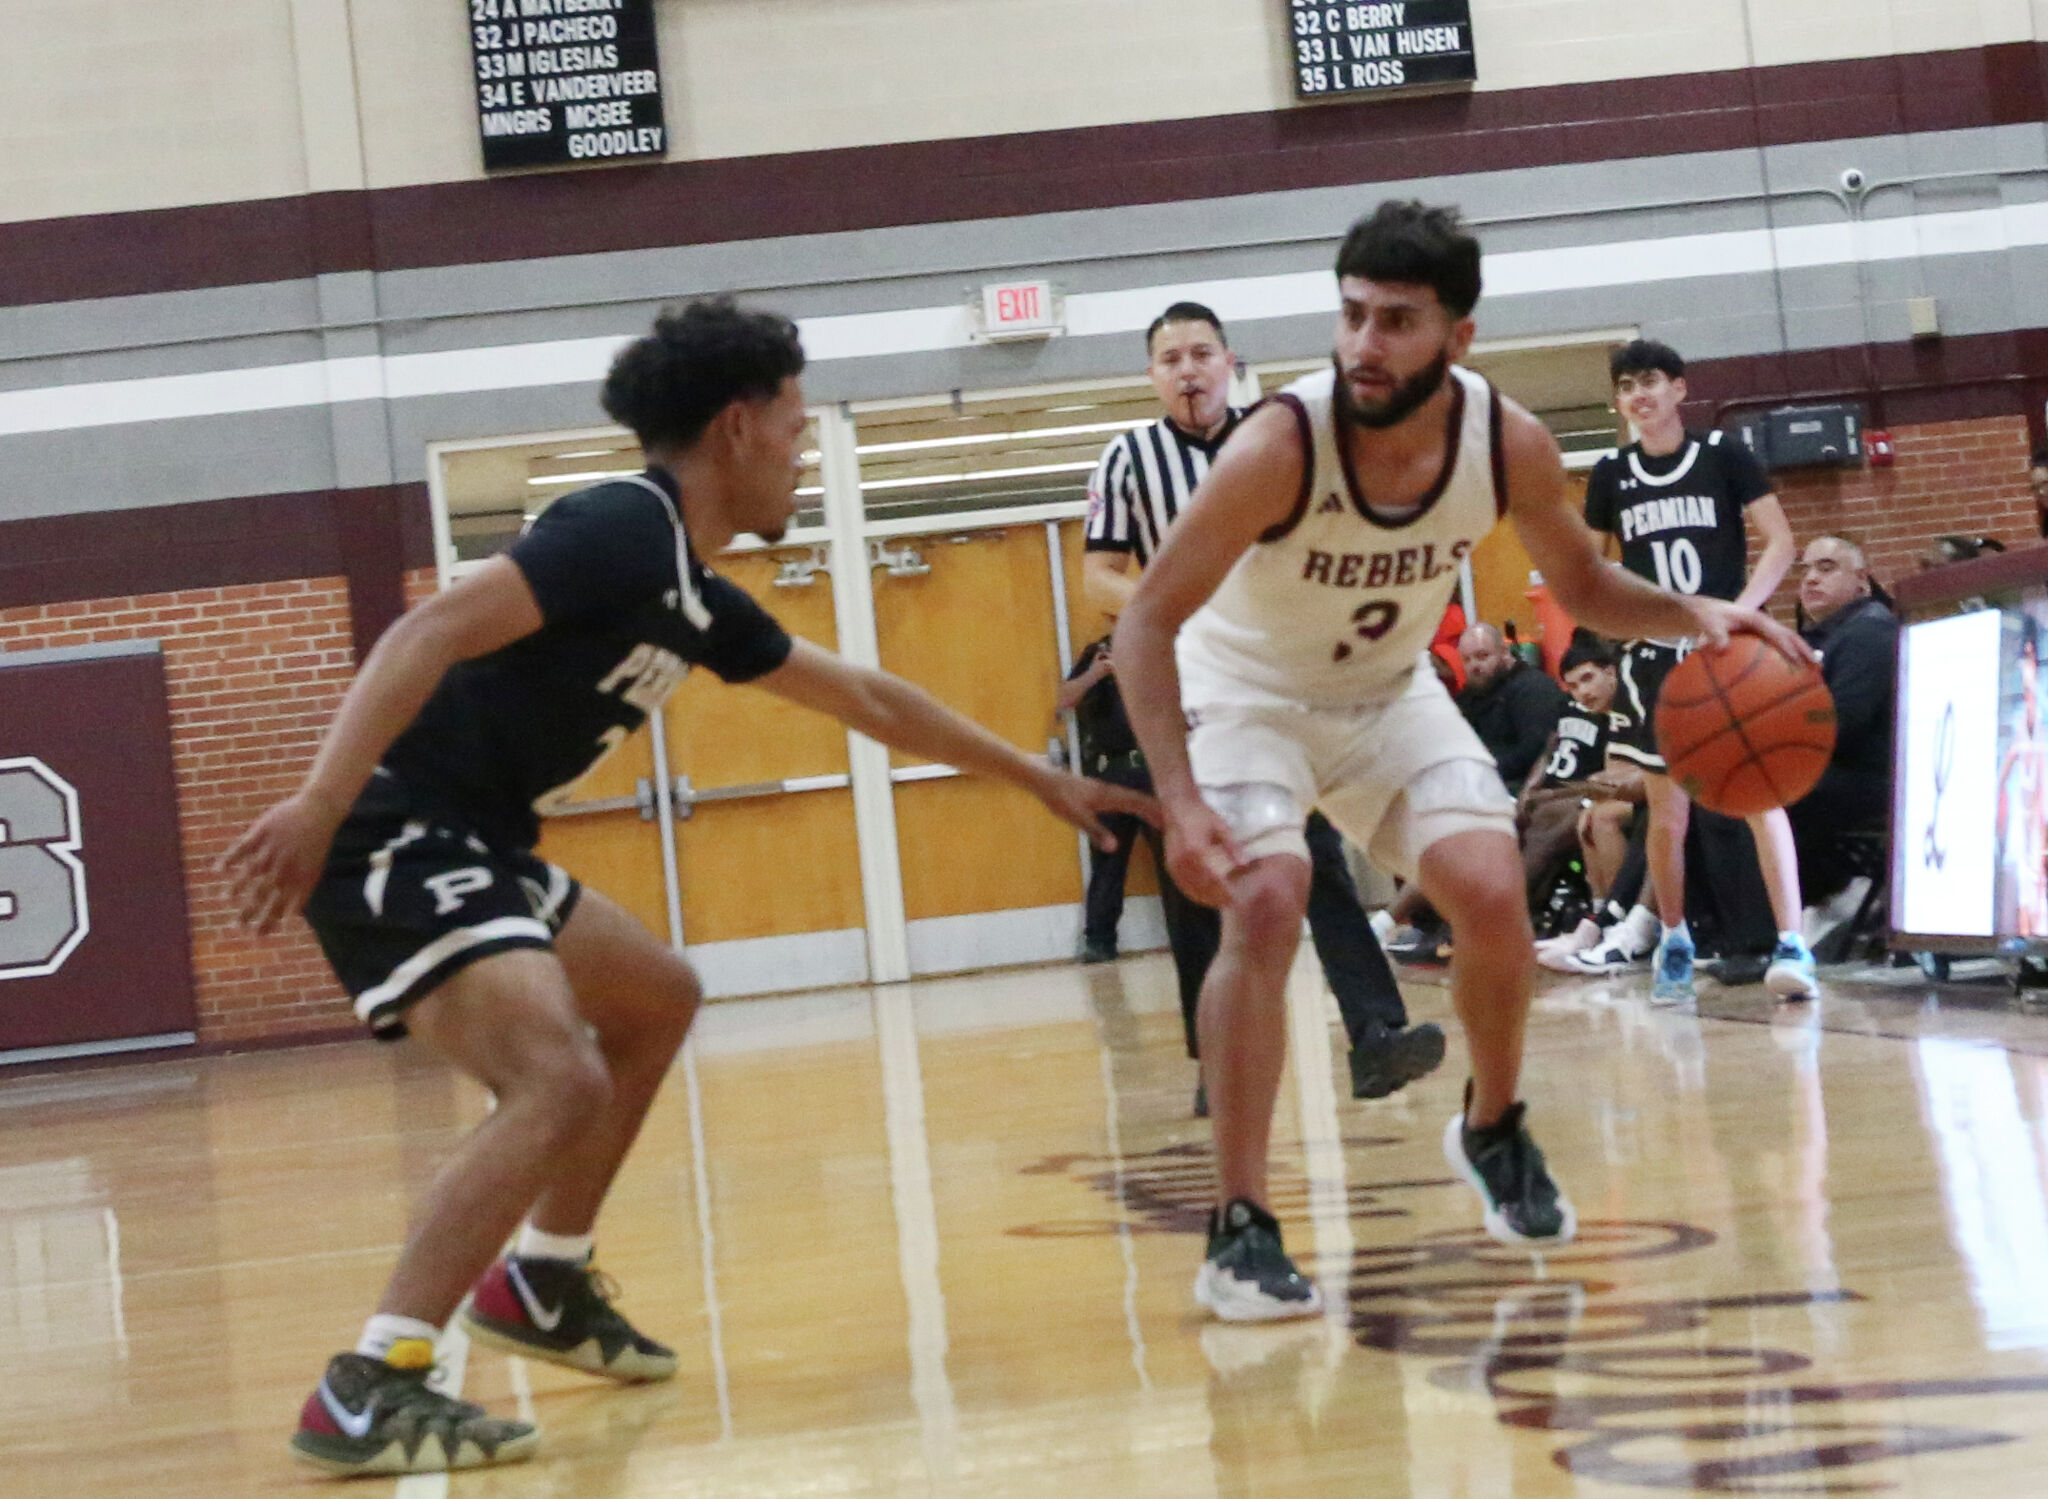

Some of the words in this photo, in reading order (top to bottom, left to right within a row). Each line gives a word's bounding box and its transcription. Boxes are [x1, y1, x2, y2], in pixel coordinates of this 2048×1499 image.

[474, 25, 503, 50] 32
[506, 23, 520, 47] J
[523, 15, 618, 46] PACHECO
[1294, 10, 1322, 35] 32
[1325, 9, 1341, 33] C
[1346, 4, 1405, 31] BERRY
[477, 54, 505, 79] 33
[506, 52, 526, 77] M
[528, 44, 619, 75] IGLESIAS
[1297, 39, 1326, 64] 33
[1330, 37, 1344, 61] L
[1349, 33, 1391, 59] VAN
[1396, 26, 1460, 55] HUSEN
[480, 84, 508, 109] 34
[511, 81, 526, 106] E
[531, 70, 657, 103] VANDERVEER
[1301, 67, 1328, 92] 35
[1333, 66, 1346, 89] L
[1352, 60, 1405, 88] ROSS
[481, 108, 552, 137] MNGRS
[565, 100, 632, 129] MCGEE
[568, 127, 663, 158] GOODLEY
[997, 286, 1038, 322] EXIT
[1620, 495, 1718, 542] PERMIAN
[1302, 538, 1472, 589] REBELS
[1650, 538, 1702, 595] 10
[422, 865, 495, 916] P
